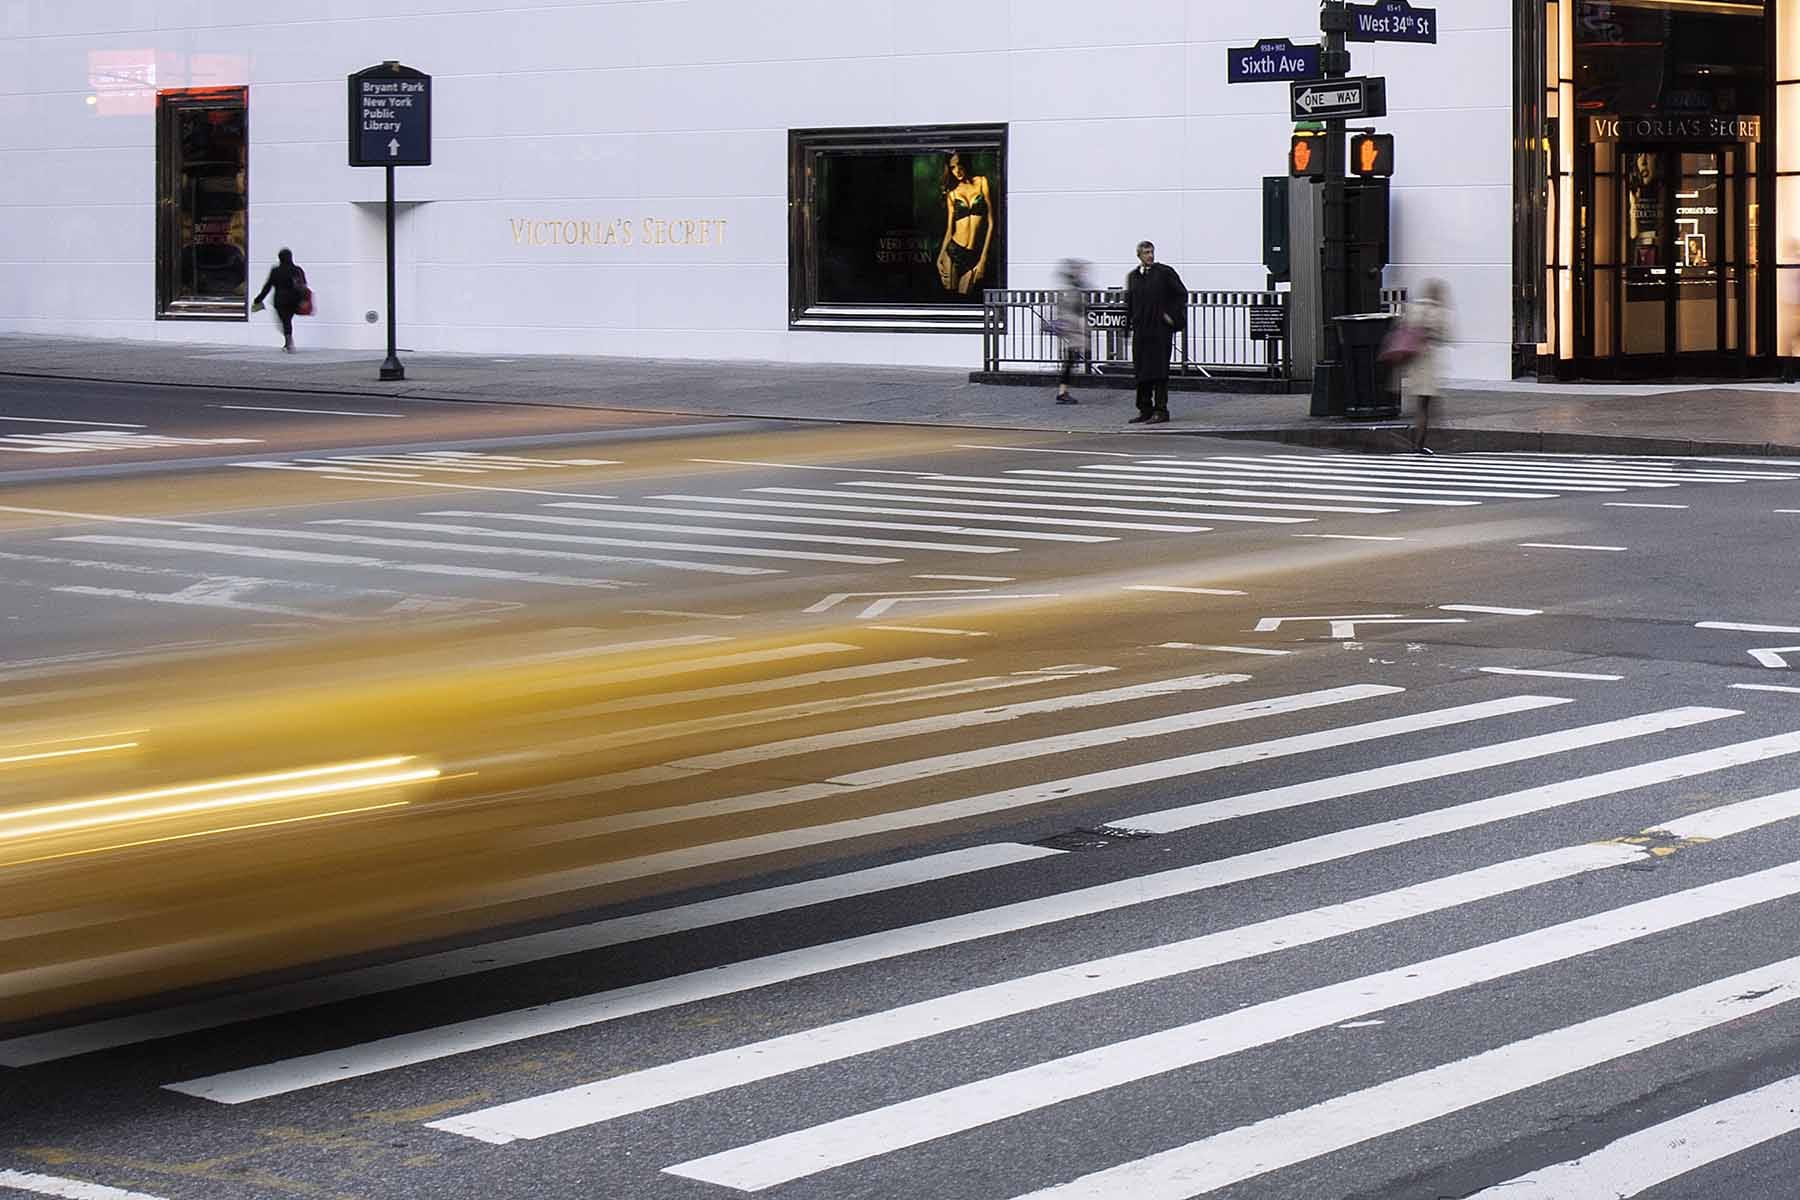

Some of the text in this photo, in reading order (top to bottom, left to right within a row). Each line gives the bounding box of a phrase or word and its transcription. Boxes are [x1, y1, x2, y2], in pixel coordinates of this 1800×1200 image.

[1360, 14, 1429, 35] West 34th St
[1241, 56, 1305, 74] Sixth Ave
[363, 82, 424, 93] Bryant Park
[363, 97, 412, 106] New York
[1305, 90, 1357, 106] ONE WAY
[363, 109, 395, 118] Public
[363, 120, 401, 132] Library
[1595, 119, 1699, 137] VICORIA'S
[510, 216, 728, 245] VICTORIA'S SECRET
[1087, 310, 1129, 328] Subwa
